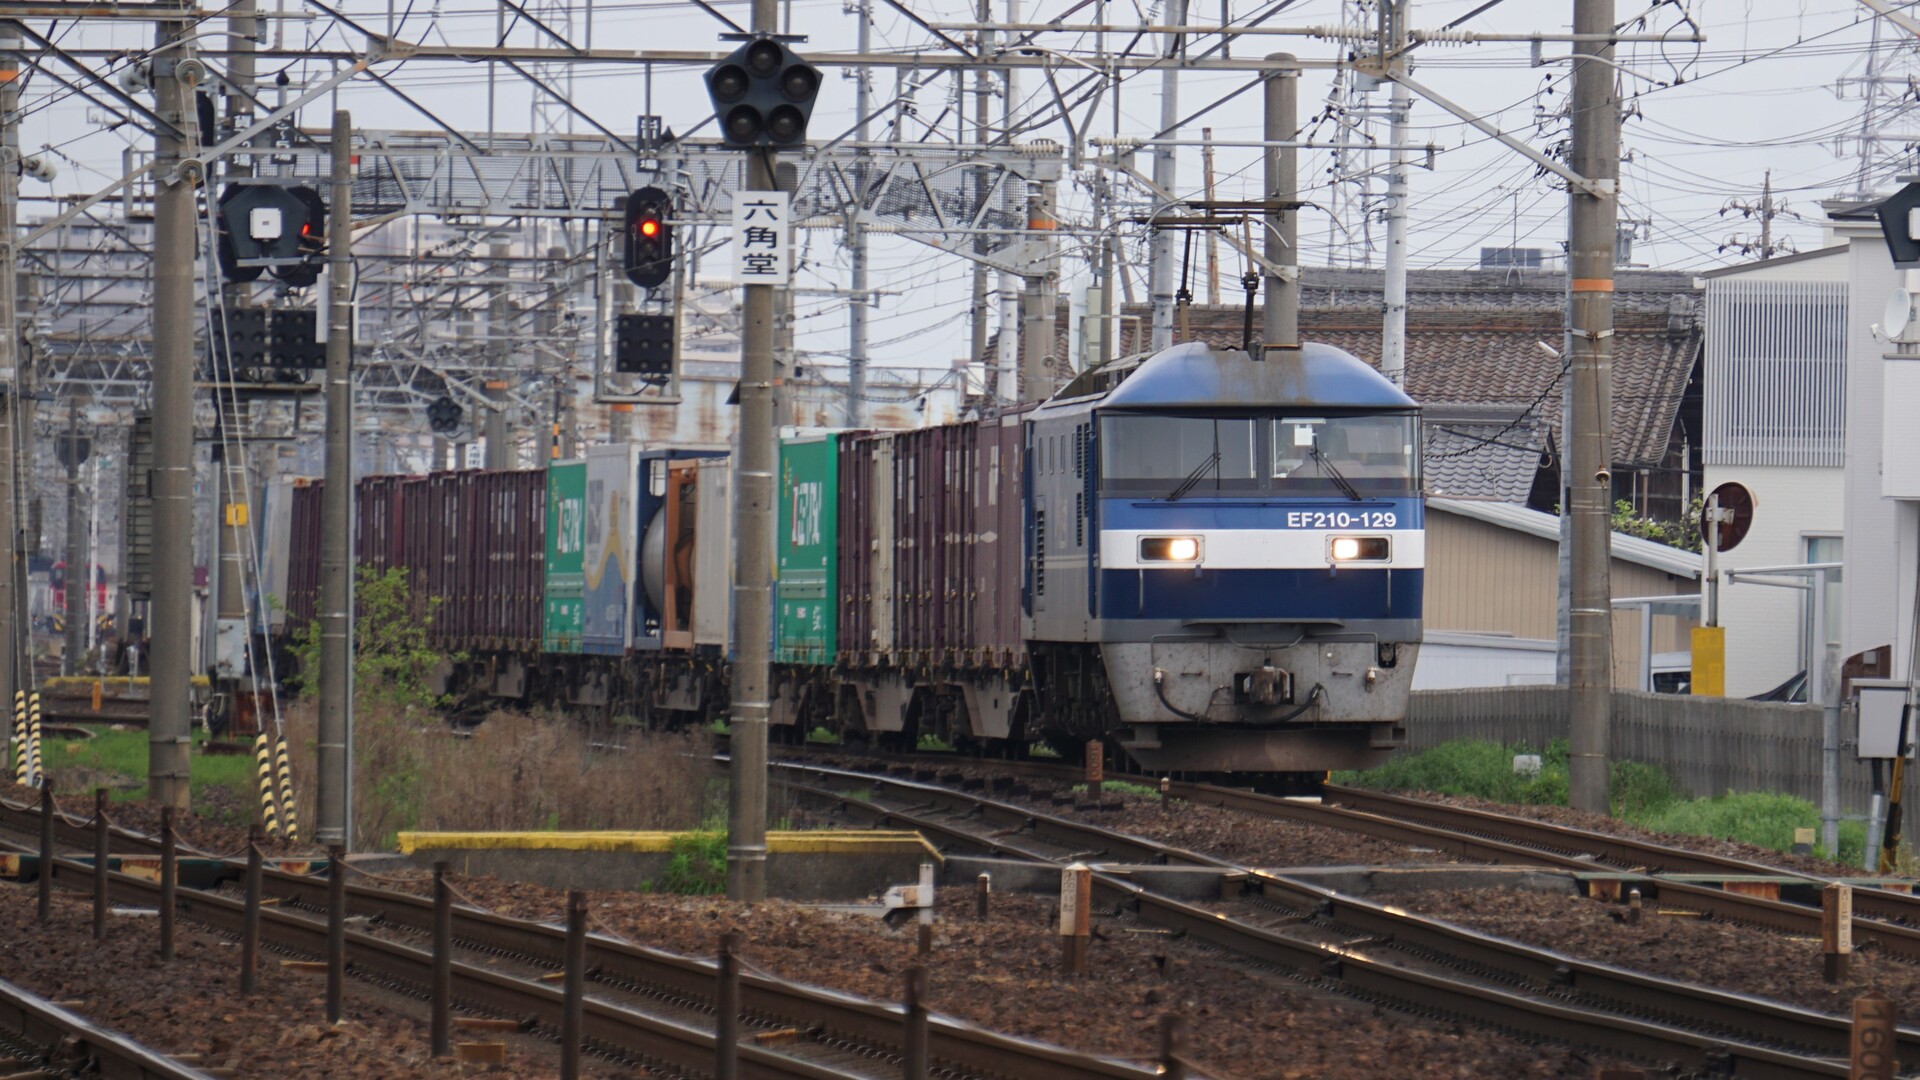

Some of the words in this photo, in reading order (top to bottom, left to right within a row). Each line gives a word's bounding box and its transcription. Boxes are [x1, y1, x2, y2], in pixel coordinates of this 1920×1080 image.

[741, 199, 778, 275] 六角堂
[1287, 512, 1397, 528] EF210-129
